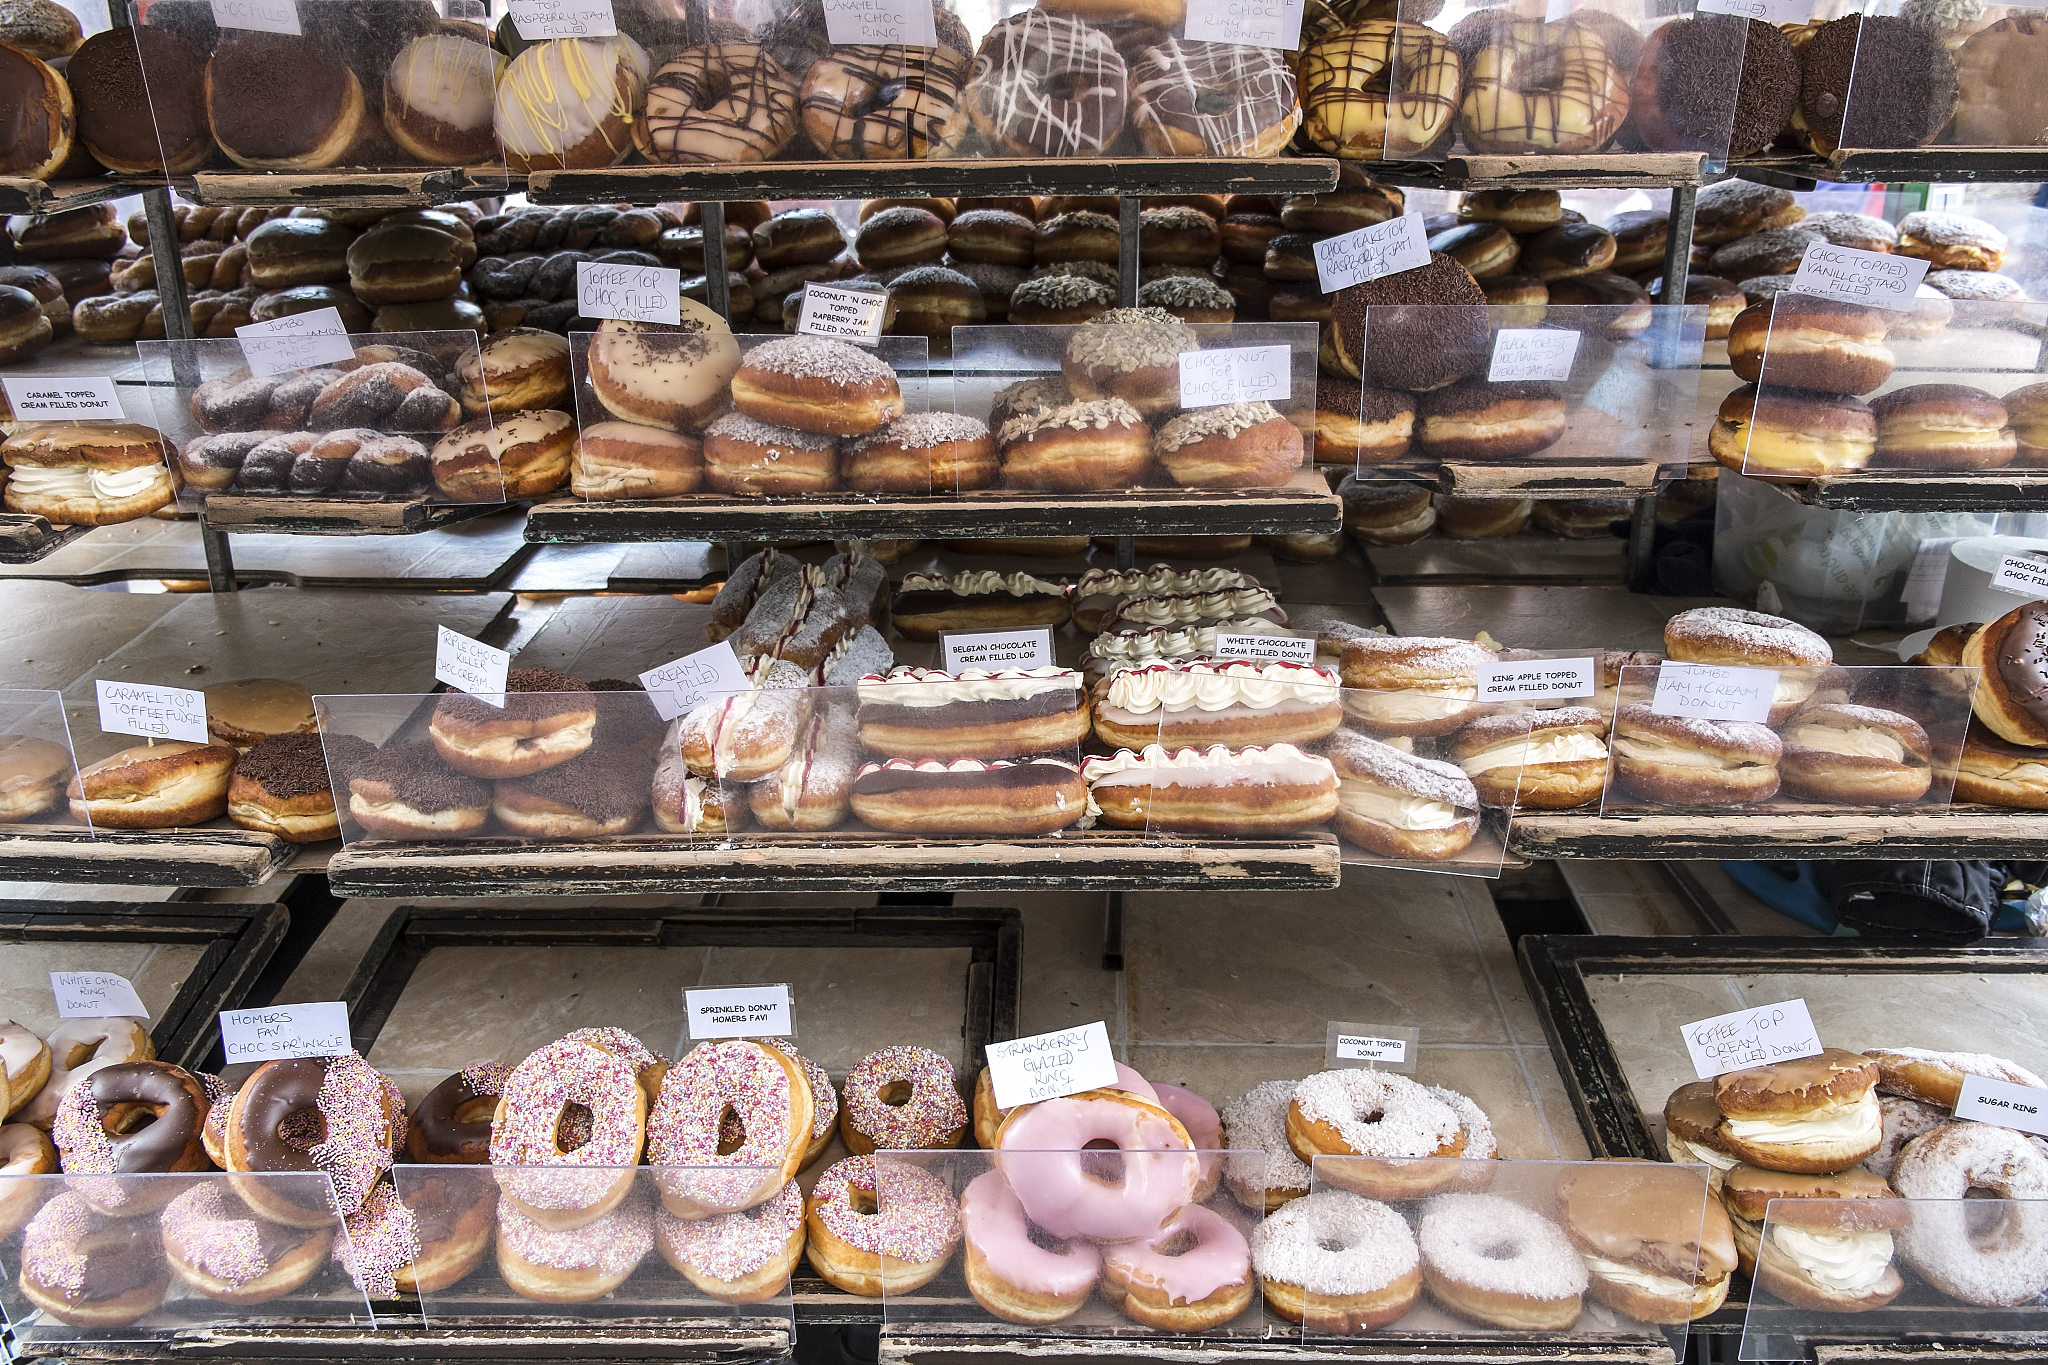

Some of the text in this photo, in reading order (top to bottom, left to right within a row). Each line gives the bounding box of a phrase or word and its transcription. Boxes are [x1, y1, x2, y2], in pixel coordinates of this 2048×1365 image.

[214, 0, 246, 17] CHOC
[536, 1, 561, 10] TOP
[825, 0, 887, 11] CARAMEL
[1229, 3, 1281, 18] CHOC
[512, 11, 611, 25] RASPBERRY JAM
[1204, 13, 1240, 29] RING
[544, 21, 588, 35] FILLED
[862, 25, 900, 42] RING
[1223, 28, 1275, 40] DONUT
[1320, 239, 1349, 260] CHOC
[1326, 236, 1412, 276] RASPBERRY JAM
[1352, 259, 1389, 282] FILLED
[1809, 248, 1908, 278] CHOC TOPPED
[582, 263, 661, 289] TOFFEE TOP
[1796, 284, 1836, 298] CREME
[1829, 280, 1871, 295] FILLED
[584, 286, 668, 309] CHOC FILLED
[808, 289, 848, 302] COCONUT
[861, 298, 882, 307] CHOC
[612, 306, 655, 320] DONUT
[829, 303, 858, 315] TOPPED
[264, 318, 304, 332] JUMBO
[812, 311, 870, 327] RAPBERRY JAM
[810, 322, 868, 337] FILLED DONUT
[244, 340, 272, 354] CHOC
[275, 341, 319, 359] TWIST
[1500, 333, 1529, 352] BLACK
[269, 355, 319, 374] DONUT
[1184, 355, 1221, 370] CHOC
[1236, 350, 1272, 362] NUT
[1209, 364, 1232, 377] TOP
[1492, 364, 1525, 379] CHERRY
[1525, 364, 1543, 376] JAM
[1183, 371, 1278, 395] CHOC FILLED
[26, 390, 96, 399] CARAMEL TOPPED
[1211, 388, 1269, 402] DONUT
[20, 400, 109, 409] CREAM FILLED DONUT
[2004, 569, 2030, 581] CHOC
[952, 640, 1037, 654] BELGIAN CHOCOLATE
[1226, 637, 1307, 649] WHITE CHOCOLATE
[469, 644, 502, 666] CHOC
[960, 651, 1036, 663] CREAM FILLED LOG
[1220, 647, 1311, 659] CREAM FILLED DONUT
[456, 651, 488, 673] KILLER
[437, 657, 488, 689] CHOC CREAM
[649, 658, 701, 688] CREAM
[676, 663, 720, 692] FILLED
[1491, 671, 1578, 682] KING APPLE TOPPED
[1682, 666, 1731, 679] JUMBO
[1486, 681, 1583, 693] CREAM FILLED DONUT
[1658, 676, 1691, 693] JAM
[105, 686, 195, 708] CARAMEL TOP
[1679, 694, 1742, 711] DONUT
[109, 702, 205, 725] TOFFEE FUDGE
[127, 717, 170, 734] FILLED
[59, 973, 128, 989] WHITE CHOC
[79, 986, 106, 998] RING
[66, 999, 99, 1009] DONUT
[700, 1003, 778, 1015] SPRINKLED DONUT
[231, 1012, 293, 1026] HOMERS
[712, 1015, 747, 1024] HOMERS
[1689, 1009, 1785, 1046] TOFFEE TOP
[228, 1036, 344, 1055] CHOC SPRINKLE
[1339, 1037, 1402, 1049] COCONUT TOPPED
[1705, 1034, 1762, 1058] CREAM
[1023, 1049, 1074, 1073] GLAZED
[1357, 1049, 1383, 1058] DONUT
[1720, 1048, 1767, 1068] FILLED
[1034, 1067, 1073, 1086] RING
[1029, 1078, 1075, 1099] DONUT
[1977, 1096, 2038, 1114] SUGAR RING
